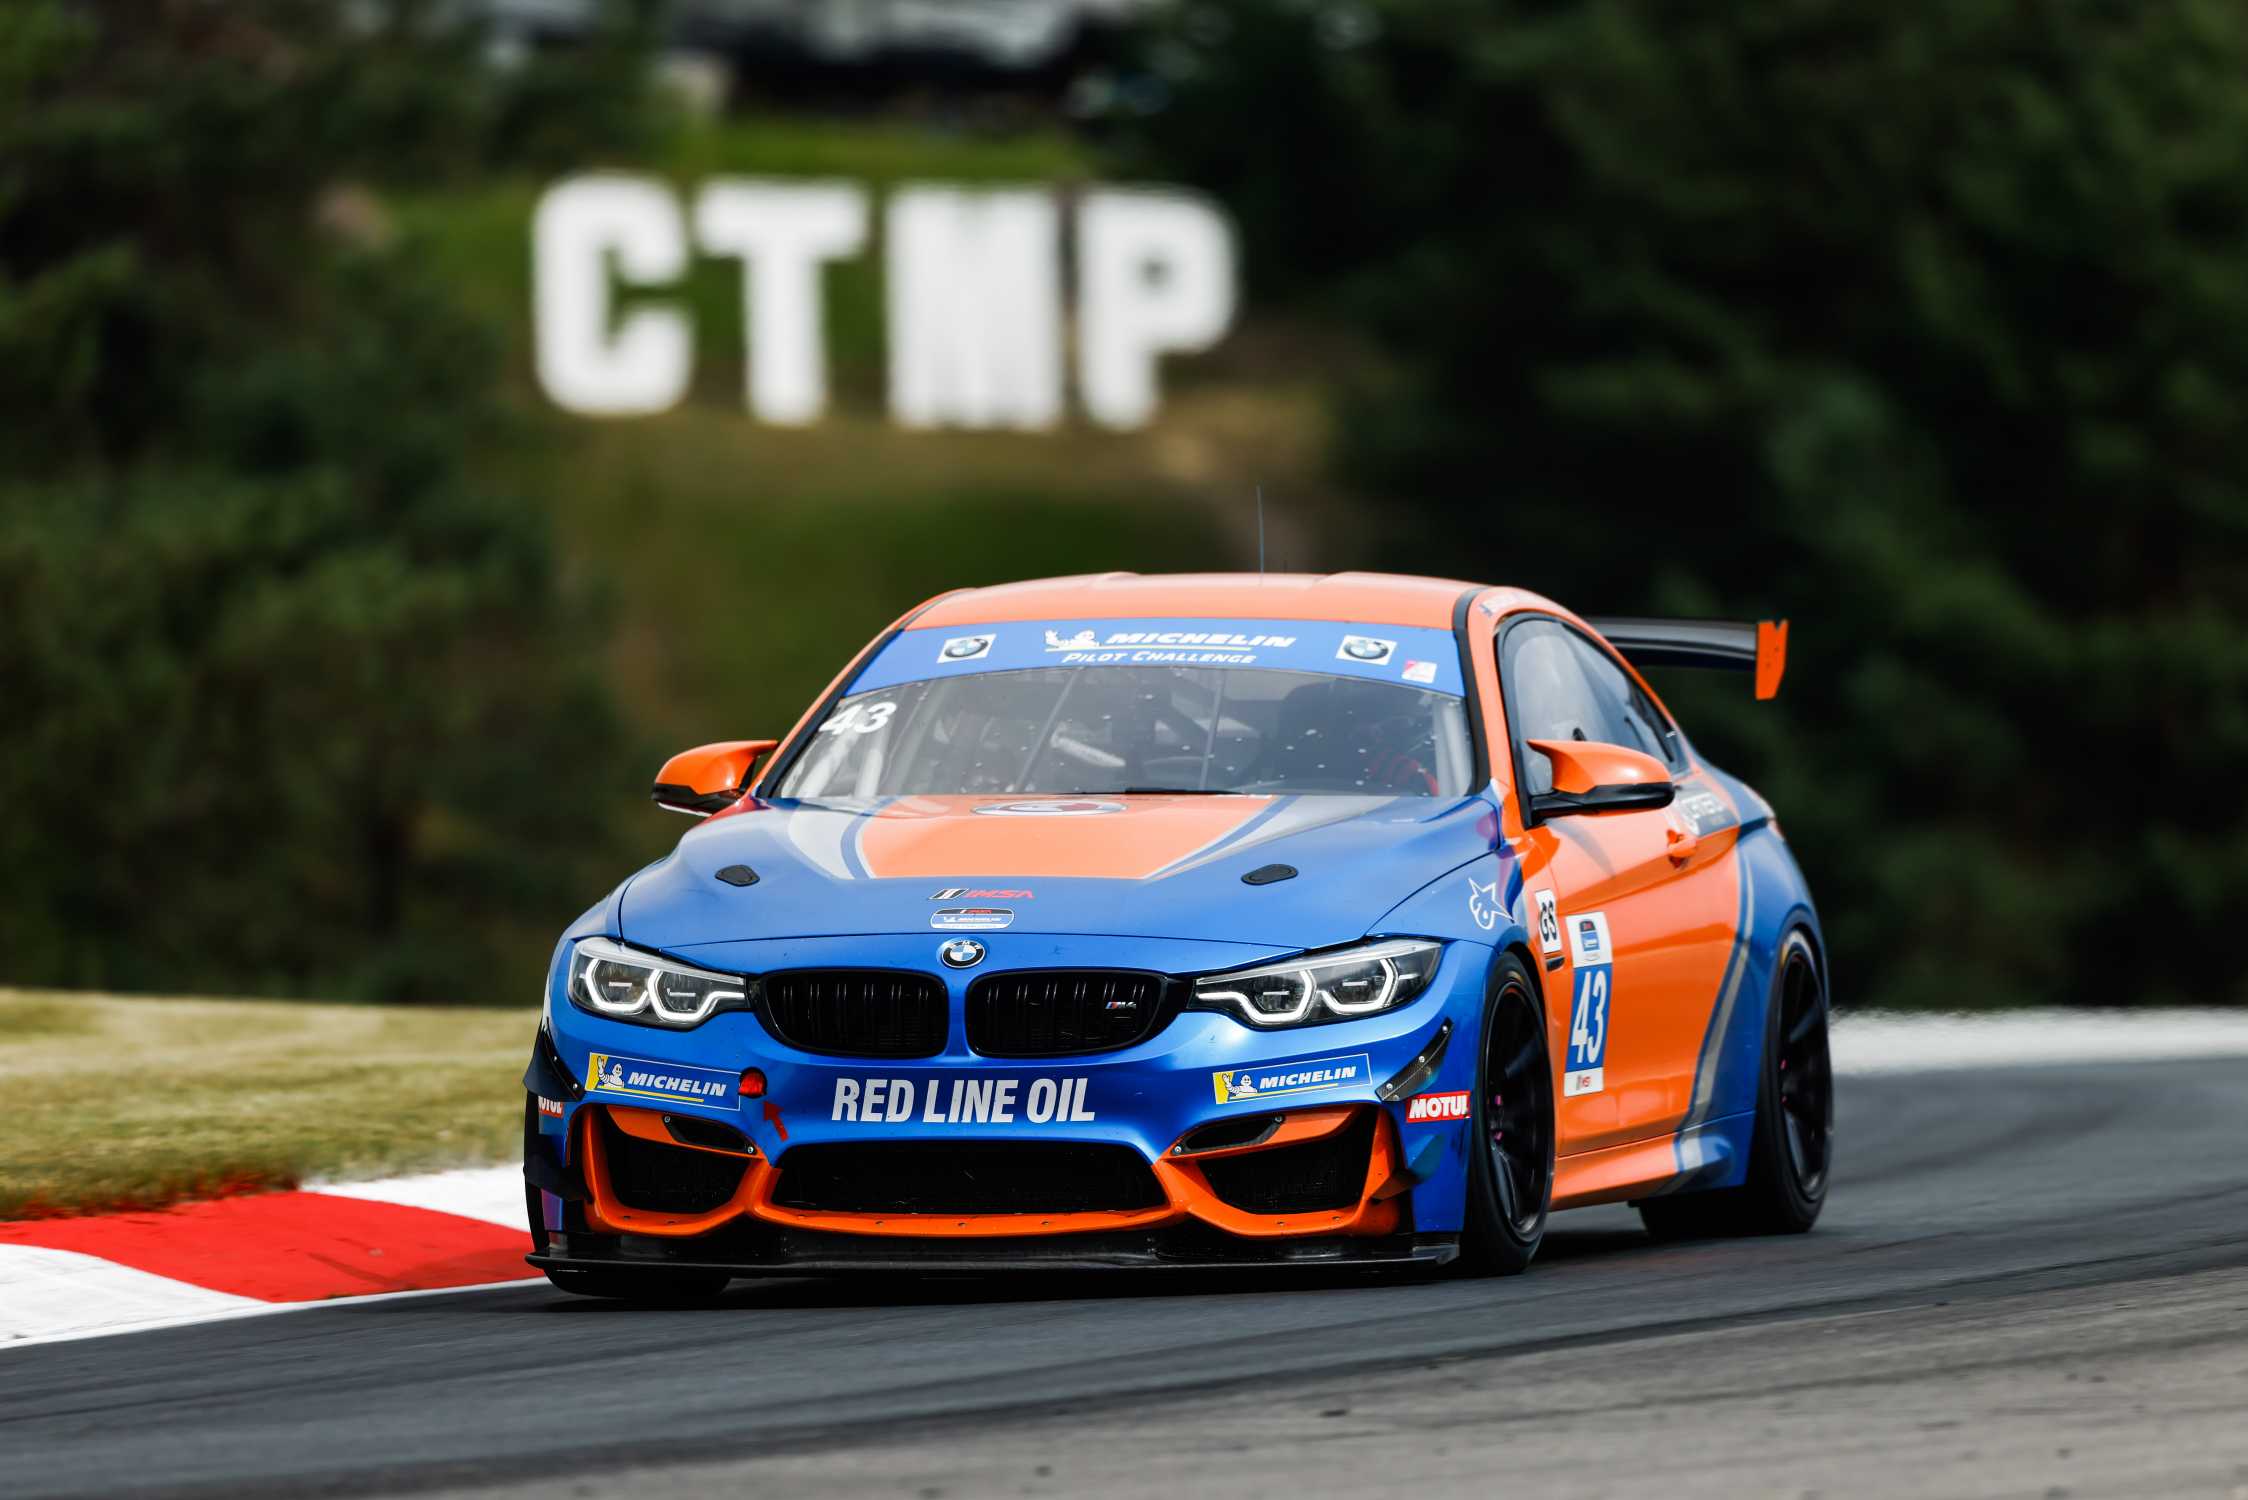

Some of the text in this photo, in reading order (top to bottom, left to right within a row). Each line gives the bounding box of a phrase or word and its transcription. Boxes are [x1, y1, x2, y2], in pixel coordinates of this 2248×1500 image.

[532, 172, 1238, 431] CTMP
[1105, 632, 1297, 648] MICHELIN
[1061, 650, 1257, 664] PILOT CHALLENGE
[818, 701, 897, 736] 43
[963, 888, 1035, 900] IMSA
[1540, 899, 1558, 943] GS
[1571, 970, 1607, 1064] 43
[627, 1071, 727, 1097] MICHELIN
[1259, 1065, 1357, 1090] MICHELIN
[831, 1078, 1096, 1124] RED LINE OIL
